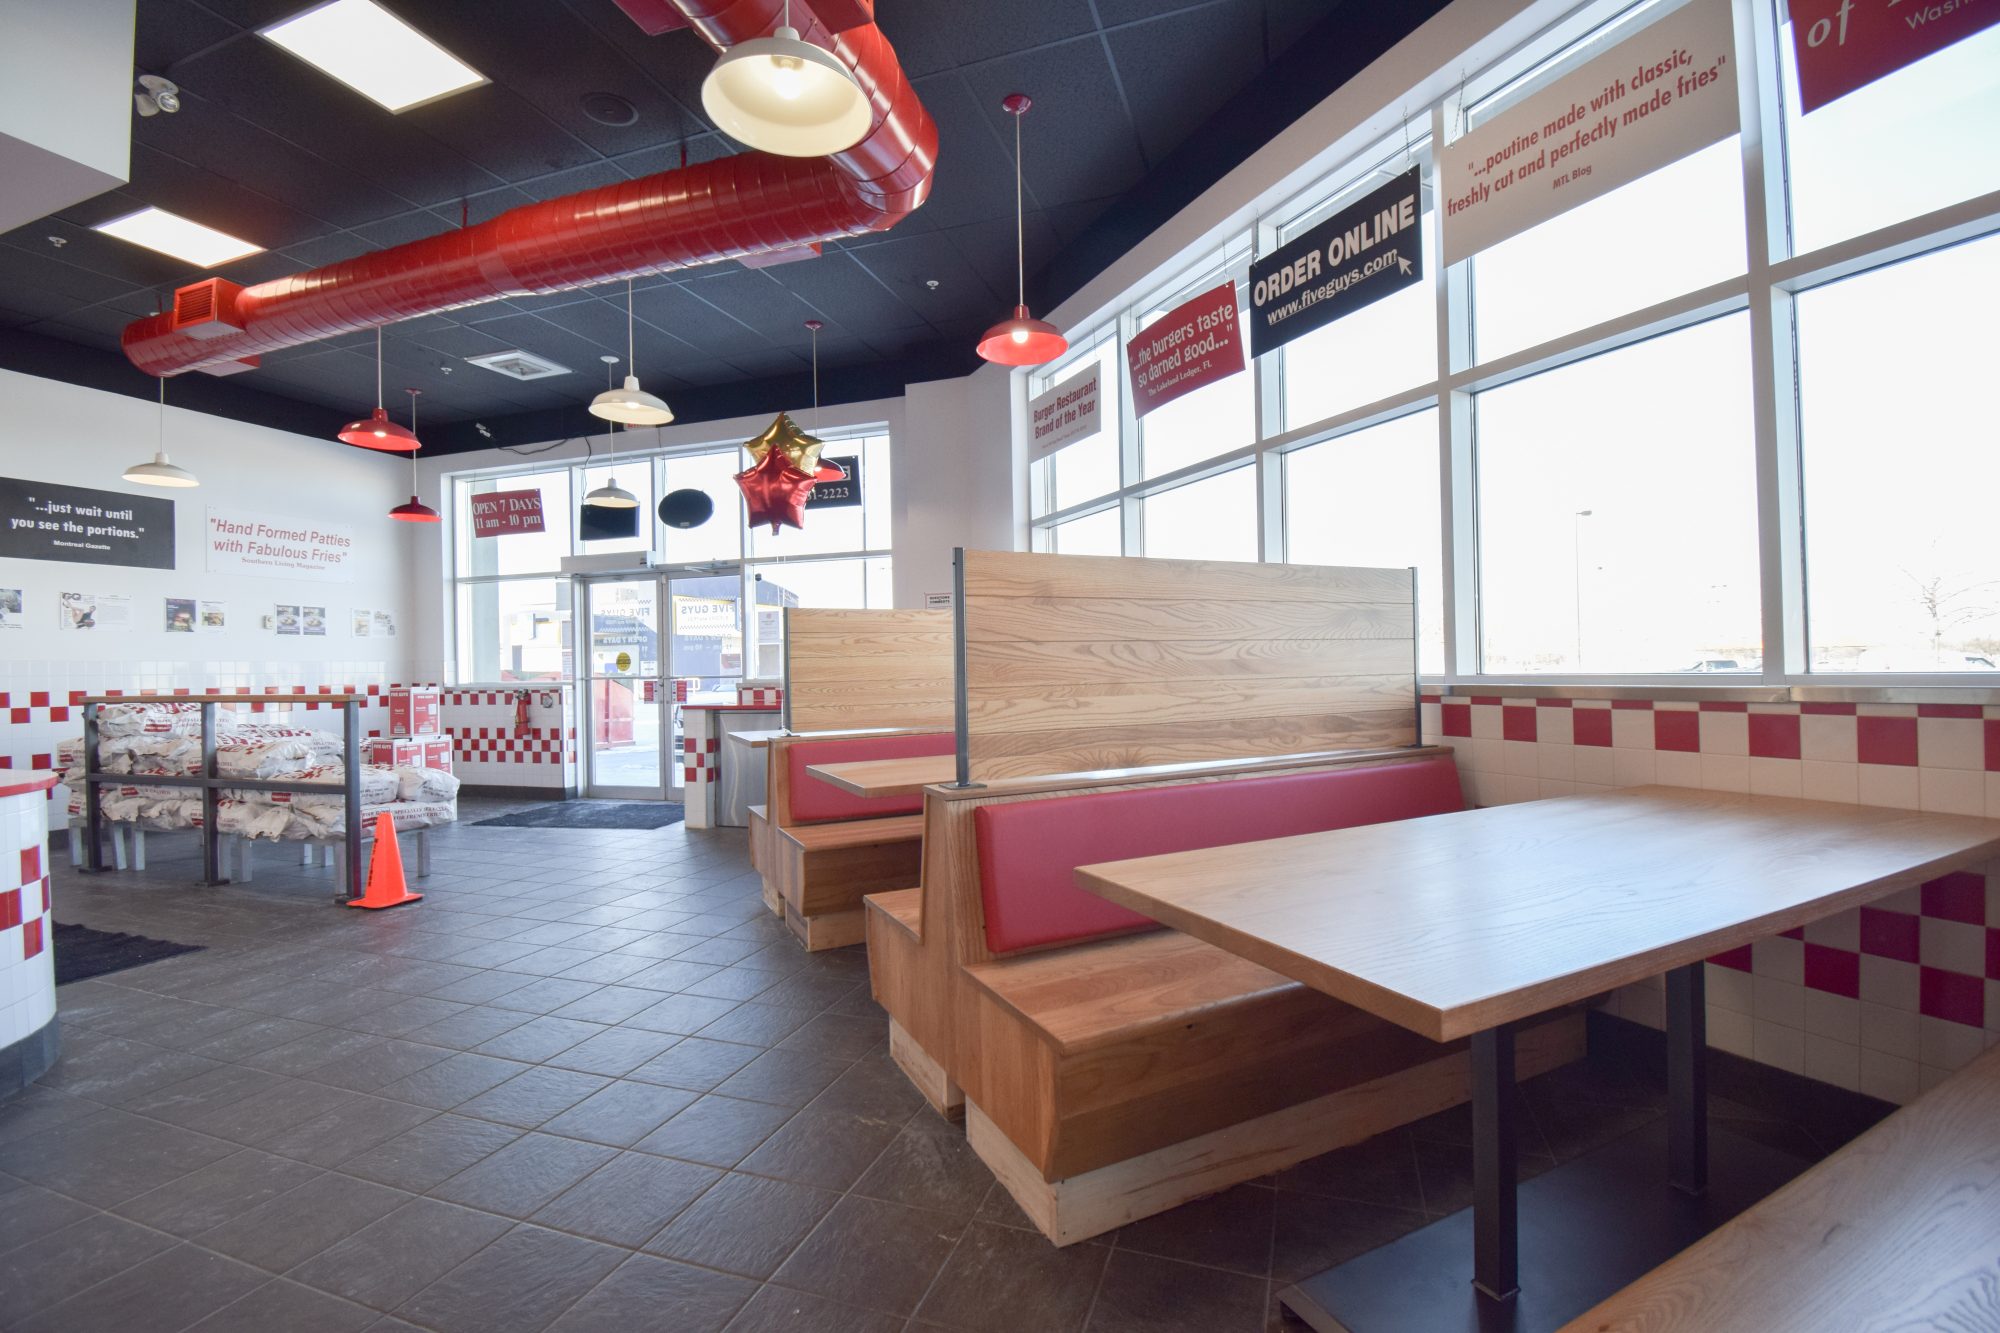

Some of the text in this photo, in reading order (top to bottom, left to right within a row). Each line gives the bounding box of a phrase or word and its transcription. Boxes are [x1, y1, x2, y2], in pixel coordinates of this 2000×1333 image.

[1807, 0, 1855, 48] of
[1543, 104, 1586, 139] made
[1590, 81, 1626, 113] with
[1631, 48, 1694, 91] classic,
[1447, 55, 1727, 217] freshly cut and perfectly made fries"
[1552, 164, 1593, 190] MTL Blog
[1253, 193, 1416, 308] ORDER ONLINE
[1267, 248, 1398, 326] www.fiveguys.com
[1152, 322, 1195, 357] burgers
[1197, 304, 1234, 333] taste
[1138, 372, 1149, 389] so
[1148, 348, 1182, 382] darned
[1203, 360, 1213, 370] FL
[1033, 376, 1097, 424] Burger Restaurant
[1034, 418, 1055, 440] Brand
[1055, 413, 1064, 430] of
[1064, 409, 1077, 425] the
[1078, 399, 1096, 418] Year
[75, 505, 103, 518] wait
[105, 509, 133, 521] until
[472, 497, 541, 516] OPEN 7 DAYS
[475, 517, 484, 529] 11
[485, 518, 500, 529] am
[508, 514, 519, 526] 10
[522, 514, 541, 528] pm
[10, 517, 145, 539] you see the portions."
[53, 539, 111, 551] Montreal Gazette
[210, 517, 351, 548] "Hand Formed Patties
[213, 538, 347, 563] with Fabulous Fries"
